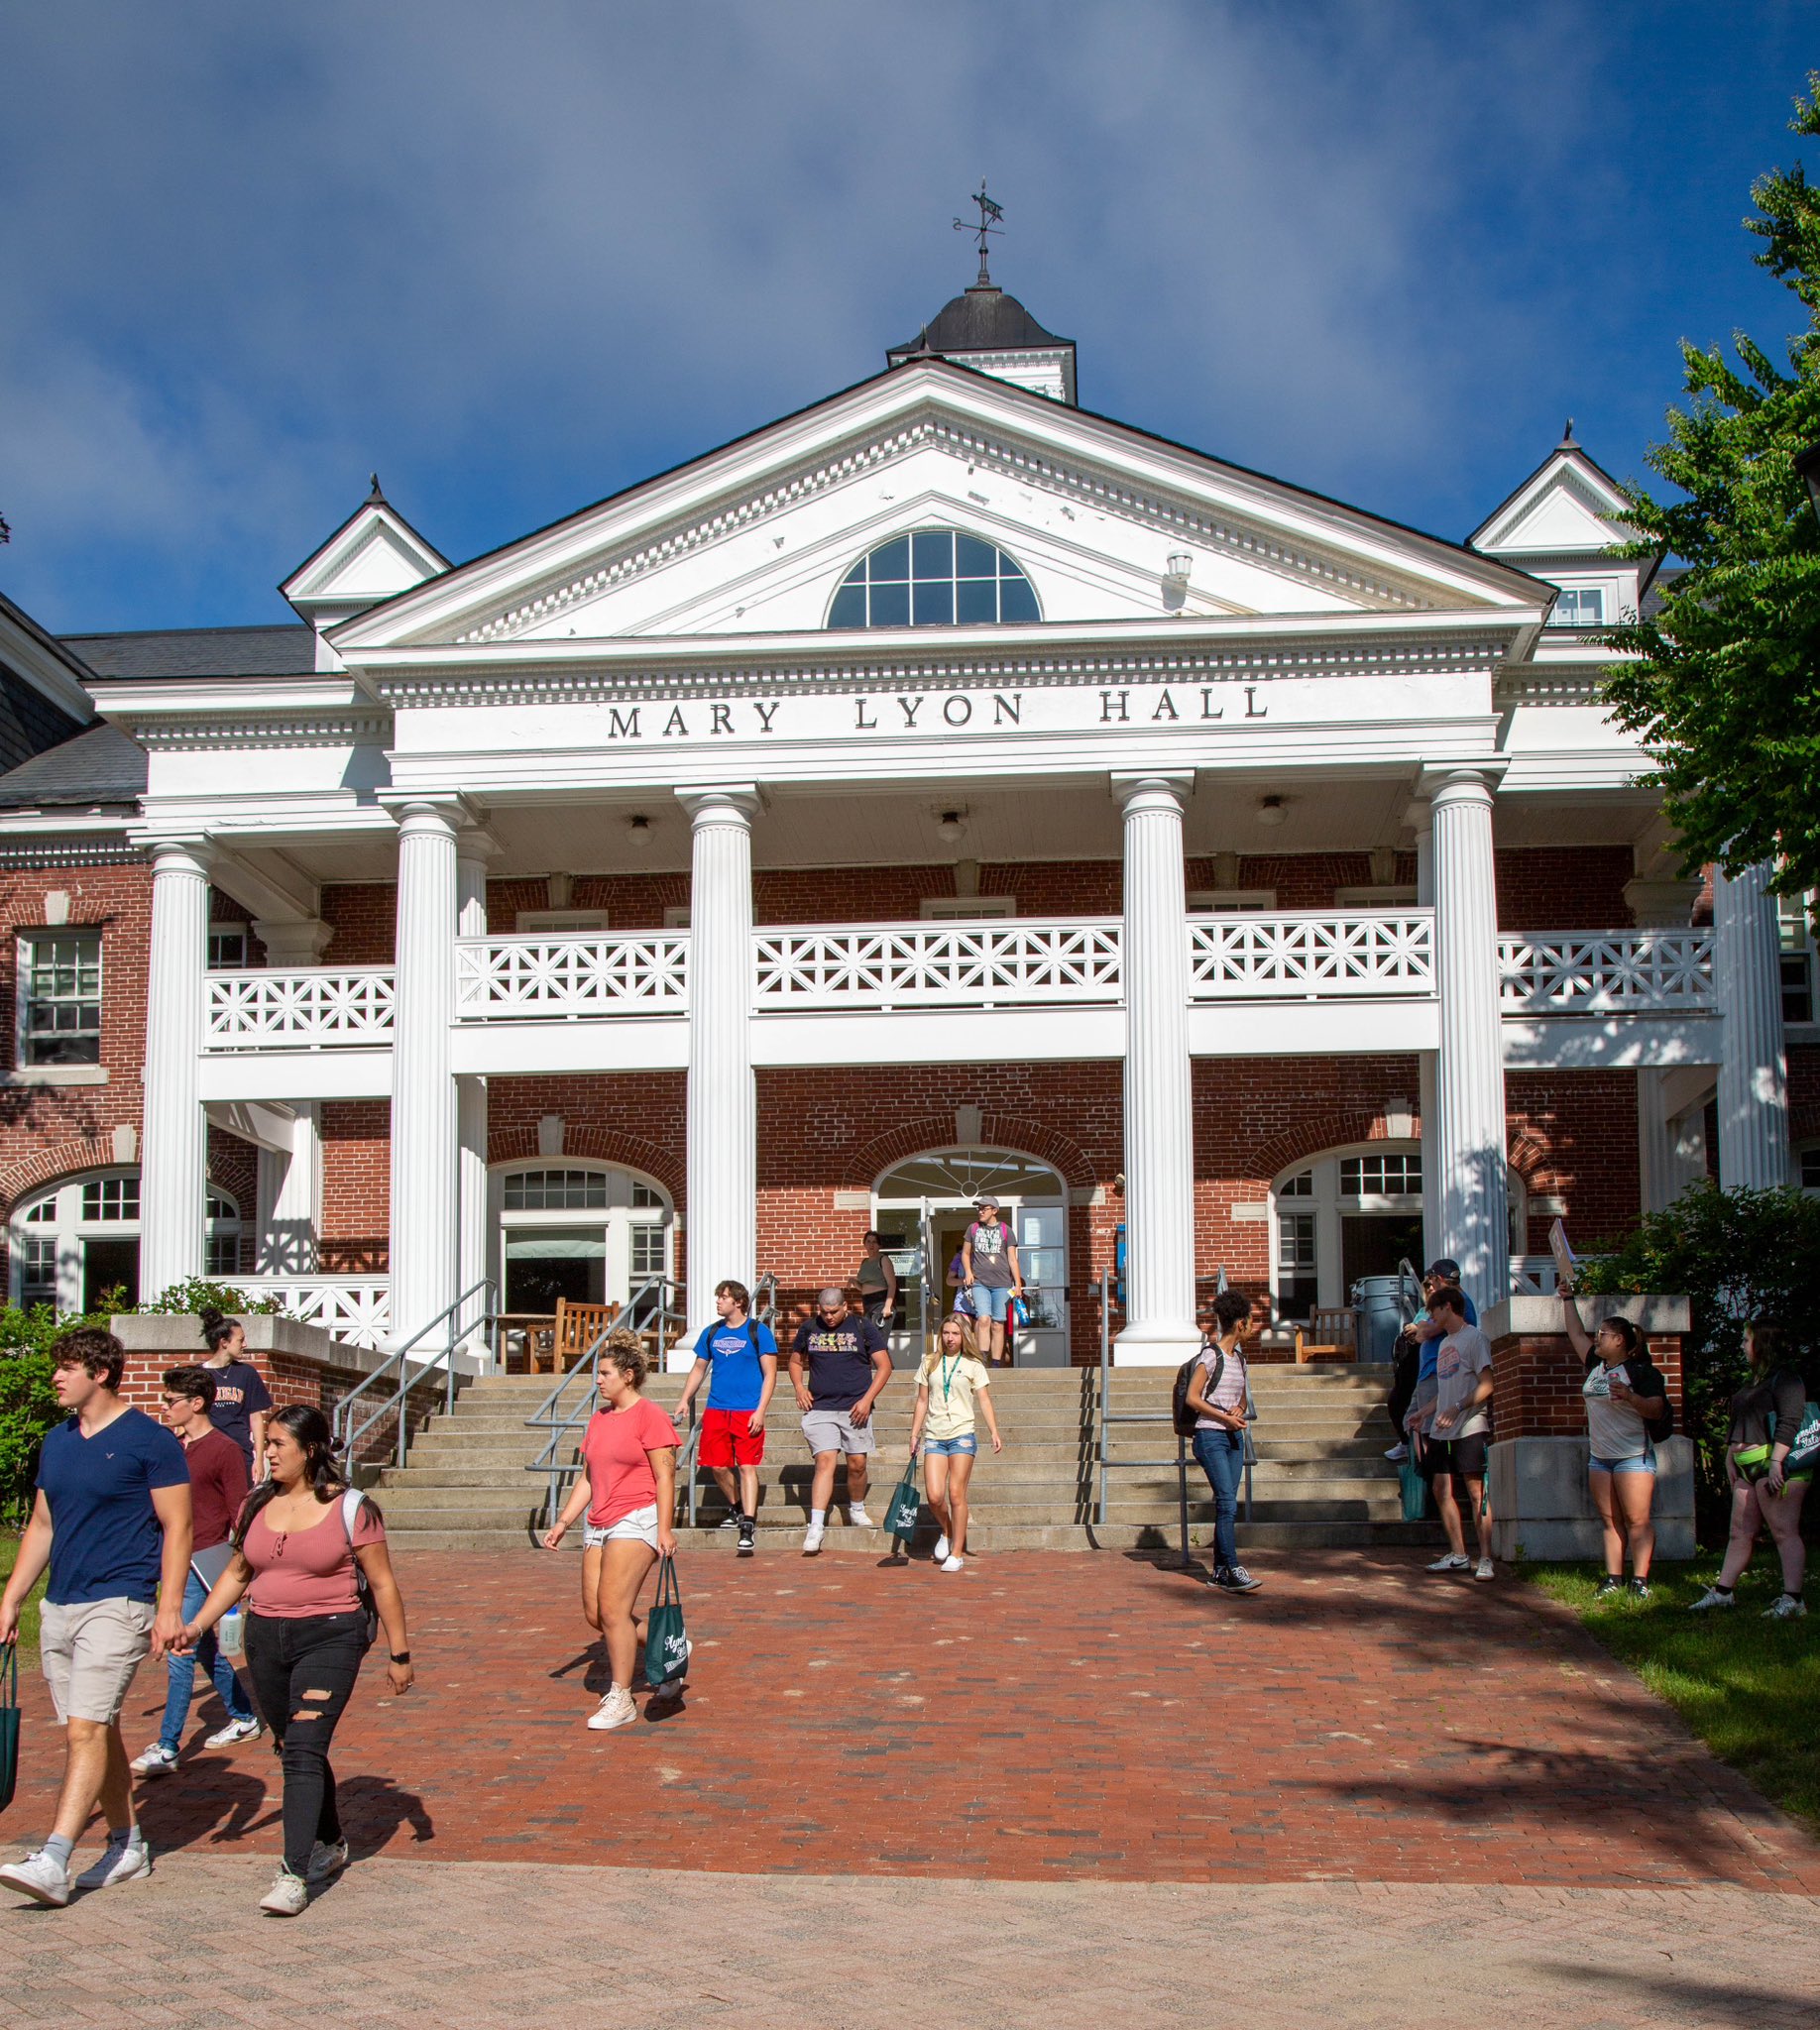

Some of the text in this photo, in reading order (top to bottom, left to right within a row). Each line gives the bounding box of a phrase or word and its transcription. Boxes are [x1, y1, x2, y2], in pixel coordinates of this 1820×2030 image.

[608, 687, 1268, 738] MARY LYON HALL
